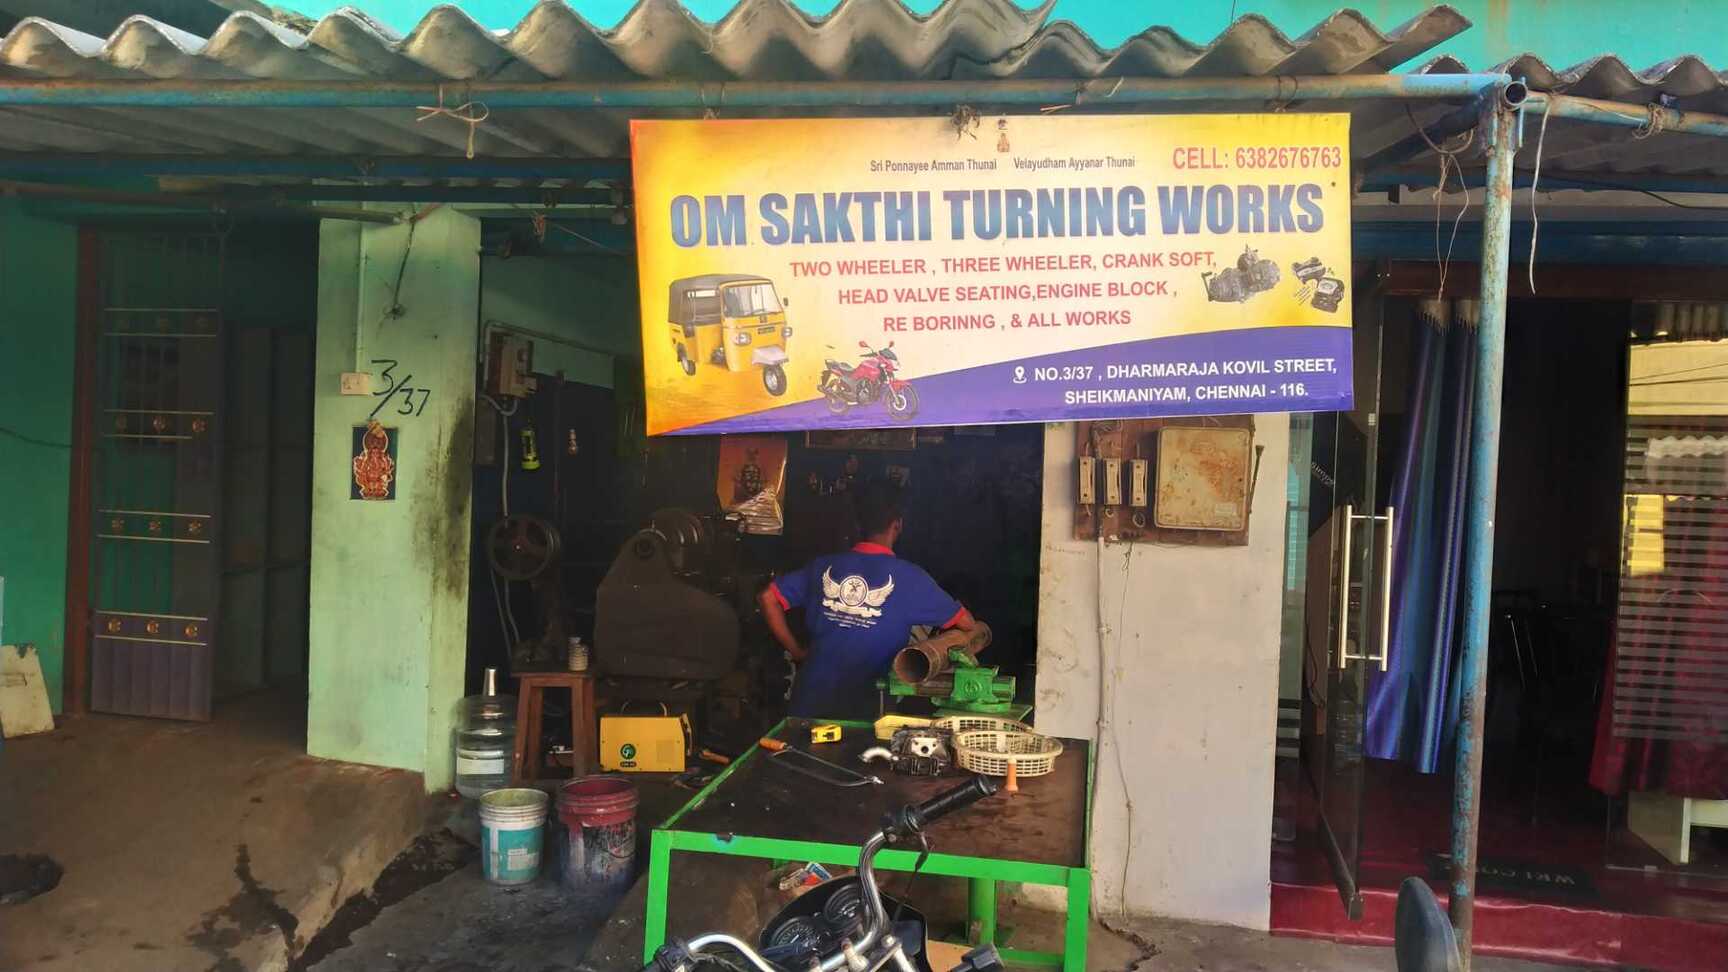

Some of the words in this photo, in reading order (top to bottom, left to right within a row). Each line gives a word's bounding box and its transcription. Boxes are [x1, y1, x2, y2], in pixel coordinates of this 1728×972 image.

[870, 160, 883, 172] Sri
[885, 160, 929, 174] Ponnayee
[931, 159, 965, 172] Amman
[967, 159, 997, 171] Thunai
[1013, 157, 1067, 172] Velayudham
[1069, 157, 1104, 172] Ayyanar
[1106, 156, 1136, 169] Thunai
[1173, 148, 1228, 169] CELL:
[1236, 147, 1341, 169] 6382676763
[670, 194, 746, 248] OM
[759, 191, 932, 246] SAKTHI
[943, 185, 1146, 241] TURNING
[1157, 183, 1325, 236] WORKS
[790, 261, 831, 278] TWO
[836, 259, 926, 276] WHEELER
[942, 257, 1000, 274] THREE
[1006, 254, 1097, 272] WHEELER,
[1102, 253, 1164, 270] CRANK
[1169, 251, 1217, 269] SOFT,
[838, 288, 888, 305] HEAD
[893, 287, 949, 304] VALVE
[1107, 281, 1168, 298] BLOCK
[883, 316, 907, 332] RE
[913, 314, 995, 332] BORINNG
[1010, 313, 1023, 328] &
[1027, 312, 1061, 328] ALL
[1065, 310, 1131, 327] WORKS
[1034, 366, 1093, 381] NO.3/37
[1107, 363, 1220, 379] DHARMARAJA
[1223, 361, 1270, 376] KOVIL
[1274, 358, 1337, 375] STREET,
[369, 359, 431, 417] 3/37
[1065, 387, 1191, 404] SHEIKMANIYAM,
[1195, 384, 1266, 400] CHENNAI
[1280, 383, 1308, 398] 116.
